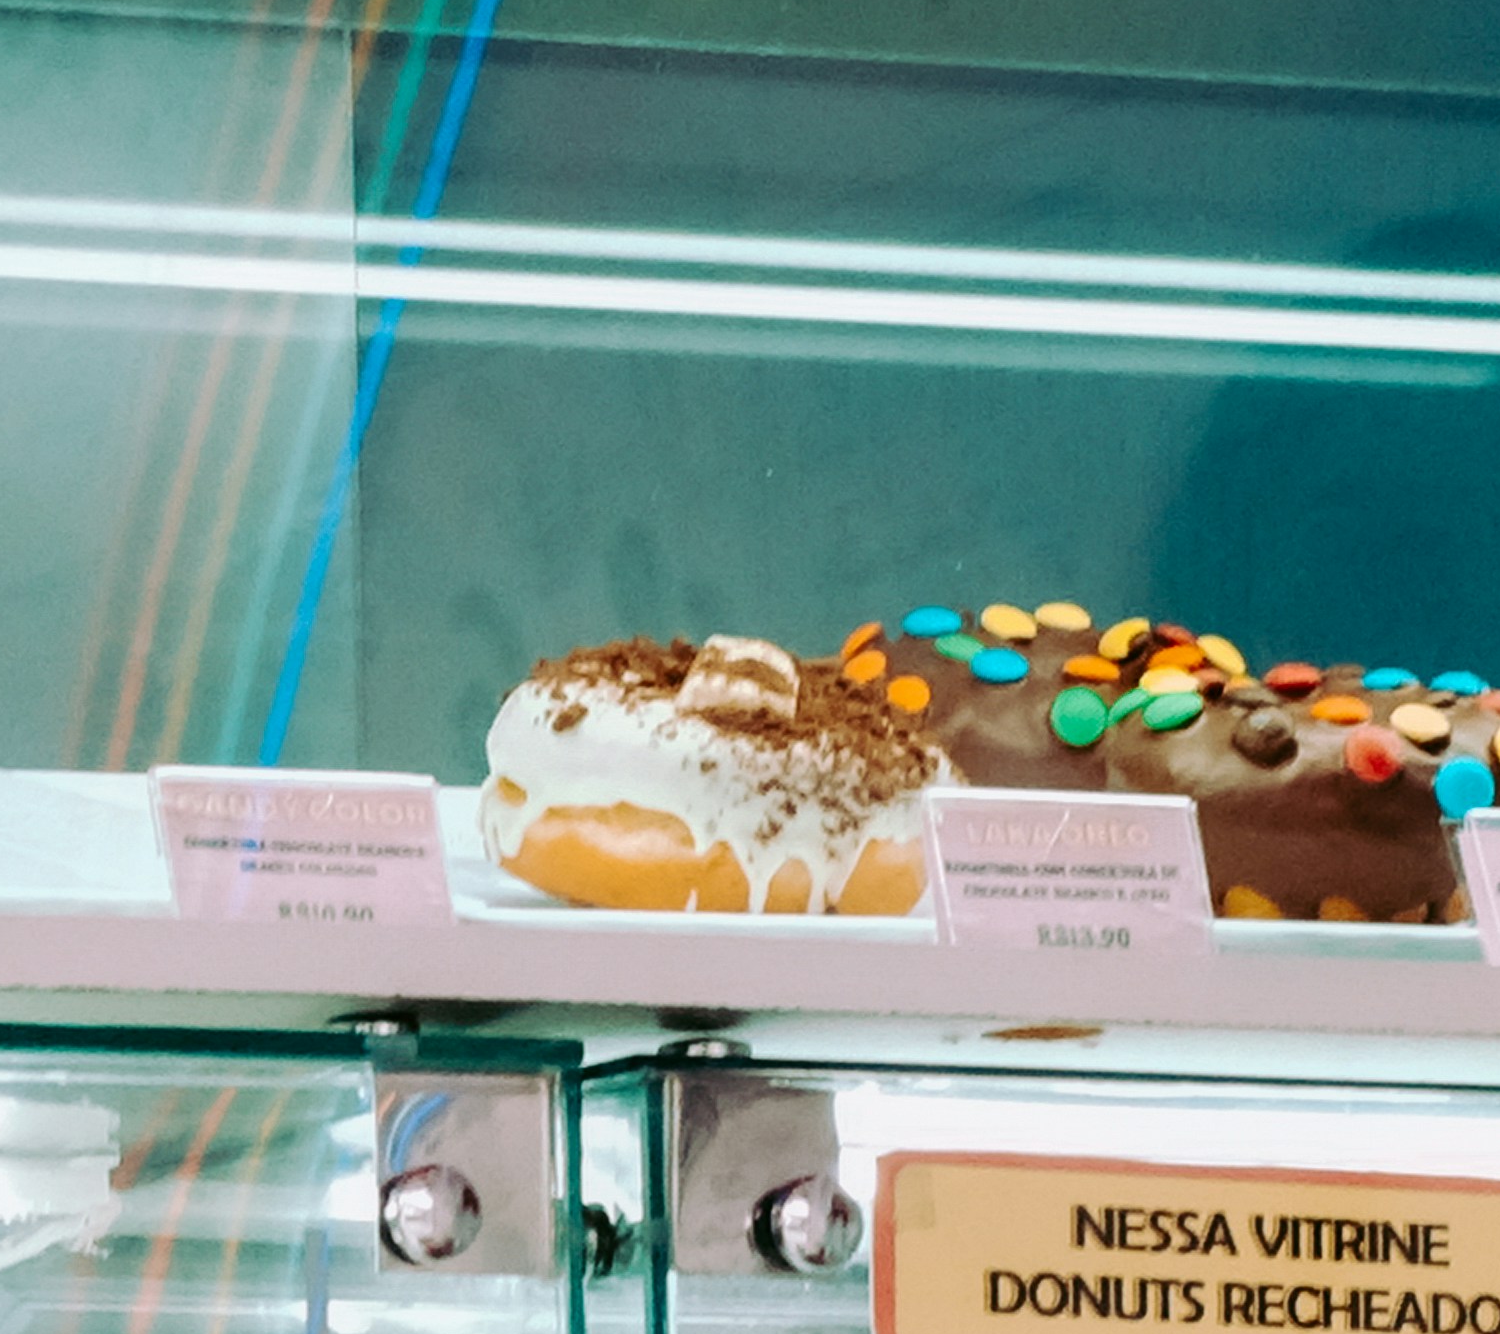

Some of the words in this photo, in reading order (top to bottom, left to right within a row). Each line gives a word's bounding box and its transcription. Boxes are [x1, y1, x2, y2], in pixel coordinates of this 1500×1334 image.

[1070, 1204, 1238, 1257] NESSA
[1252, 1213, 1452, 1268] VITRINE
[984, 1269, 1206, 1325] DONUTS
